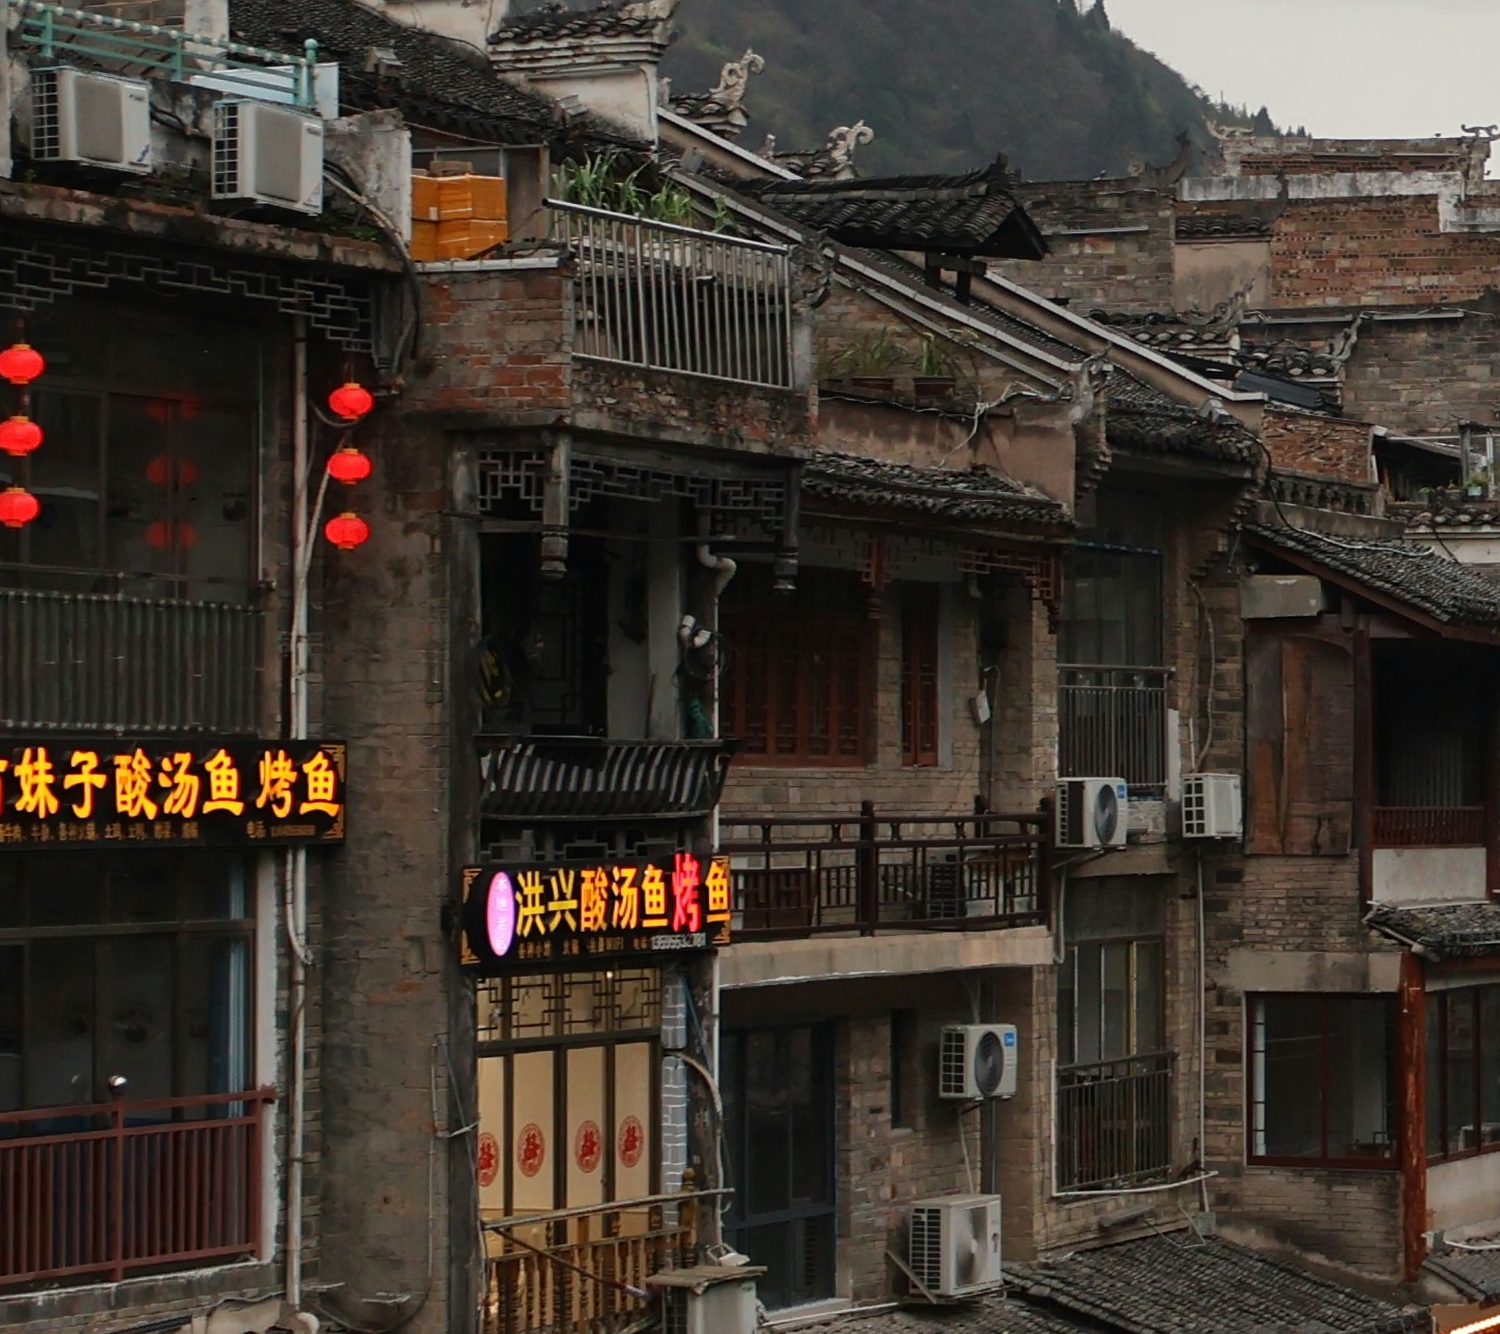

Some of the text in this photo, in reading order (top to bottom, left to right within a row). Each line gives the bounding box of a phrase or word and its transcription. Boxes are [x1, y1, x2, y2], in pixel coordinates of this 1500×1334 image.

[255, 749, 340, 818] 烤鱼
[516, 852, 731, 937] 洪兴酸汤鱼烤鱼
